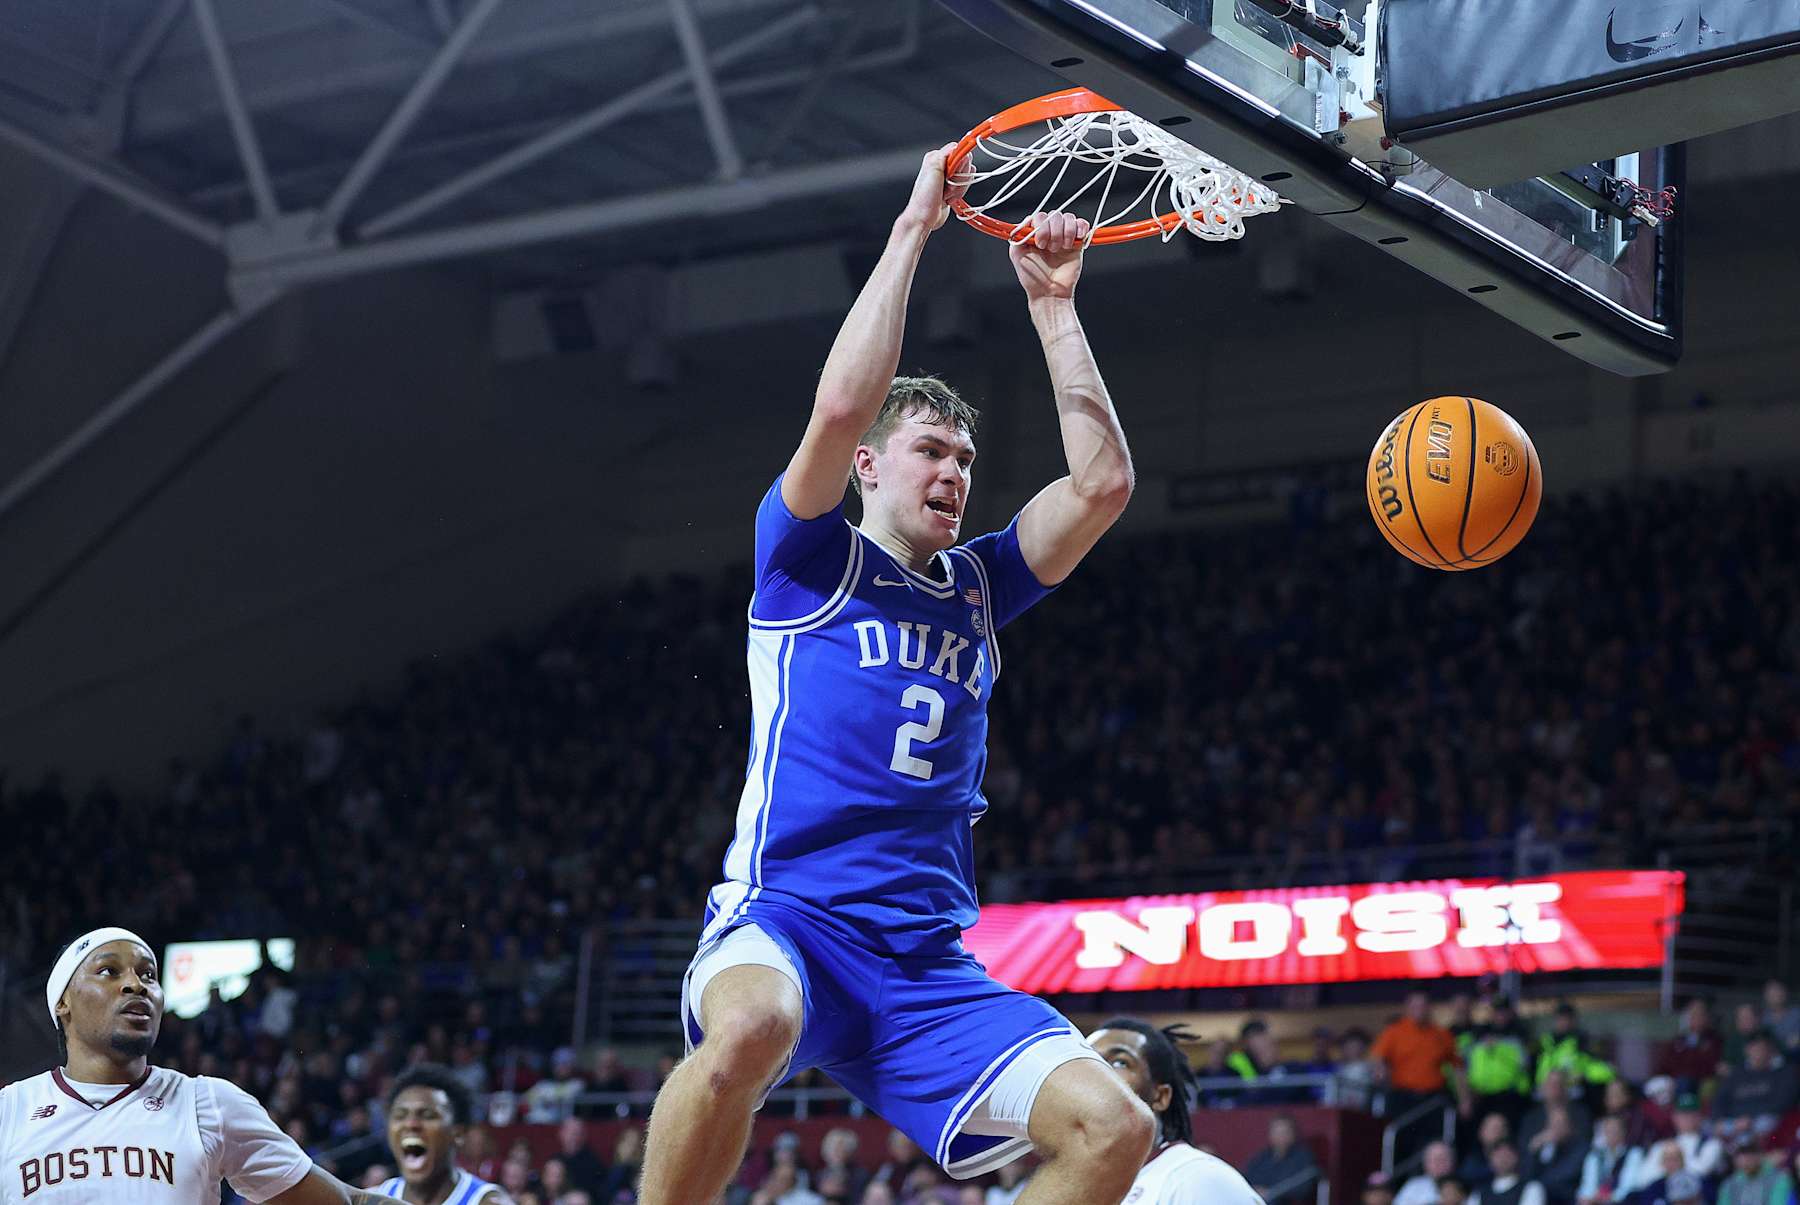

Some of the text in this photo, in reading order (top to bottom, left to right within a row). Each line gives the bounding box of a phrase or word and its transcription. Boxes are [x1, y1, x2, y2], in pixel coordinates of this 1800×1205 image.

[1427, 420, 1452, 485] EVO
[853, 620, 985, 701] DUKE
[889, 684, 945, 780] 2
[1073, 882, 1563, 970] NOISE
[19, 1146, 175, 1198] BOSTON
